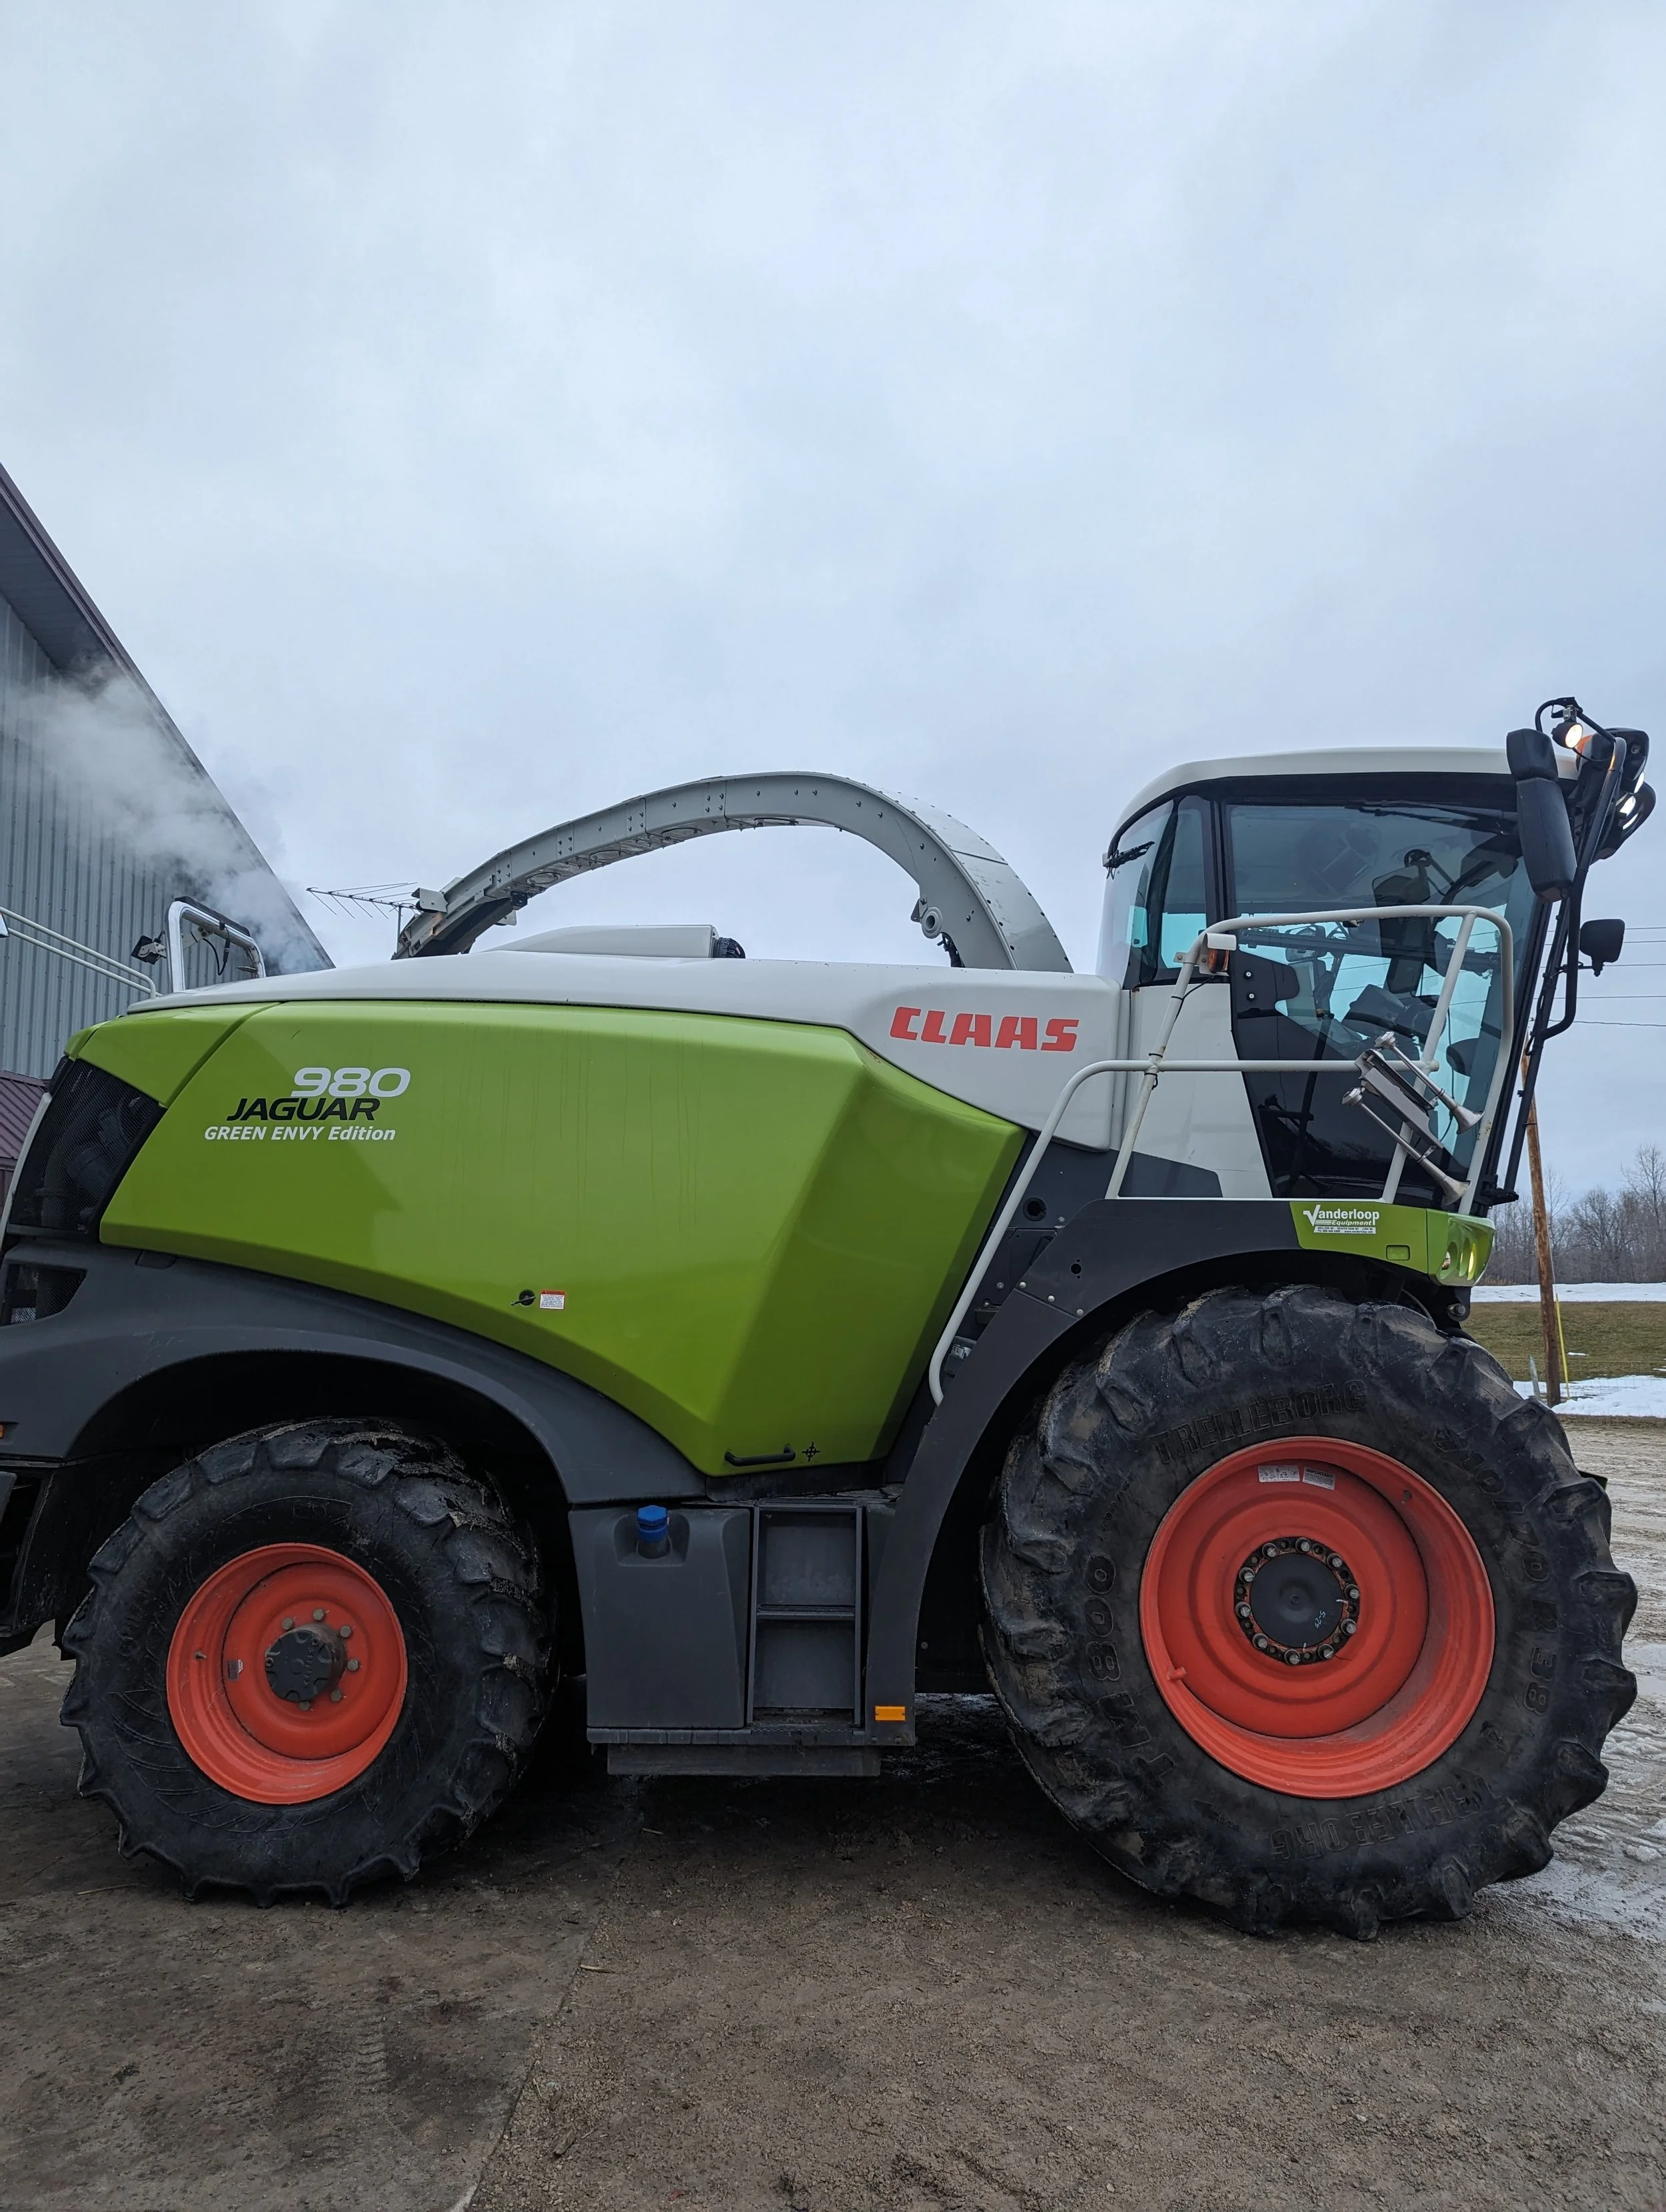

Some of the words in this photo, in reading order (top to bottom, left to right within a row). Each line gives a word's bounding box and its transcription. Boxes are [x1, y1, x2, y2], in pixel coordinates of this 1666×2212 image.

[890, 1006, 1080, 1052] CLAAS
[291, 1067, 411, 1097] 980
[227, 1098, 381, 1121] JAGUAR
[204, 1126, 267, 1140] GREEN
[271, 1126, 325, 1140] ENVY
[328, 1125, 396, 1141] Edition
[1303, 1205, 1379, 1227] Vanderloop
[1147, 1379, 1367, 1464] TRELLEBORG
[1305, 1468, 1333, 1478] IMPORTANT
[1523, 1646, 1557, 1716] 38
[1269, 1775, 1501, 1864] TRELLEBORG
